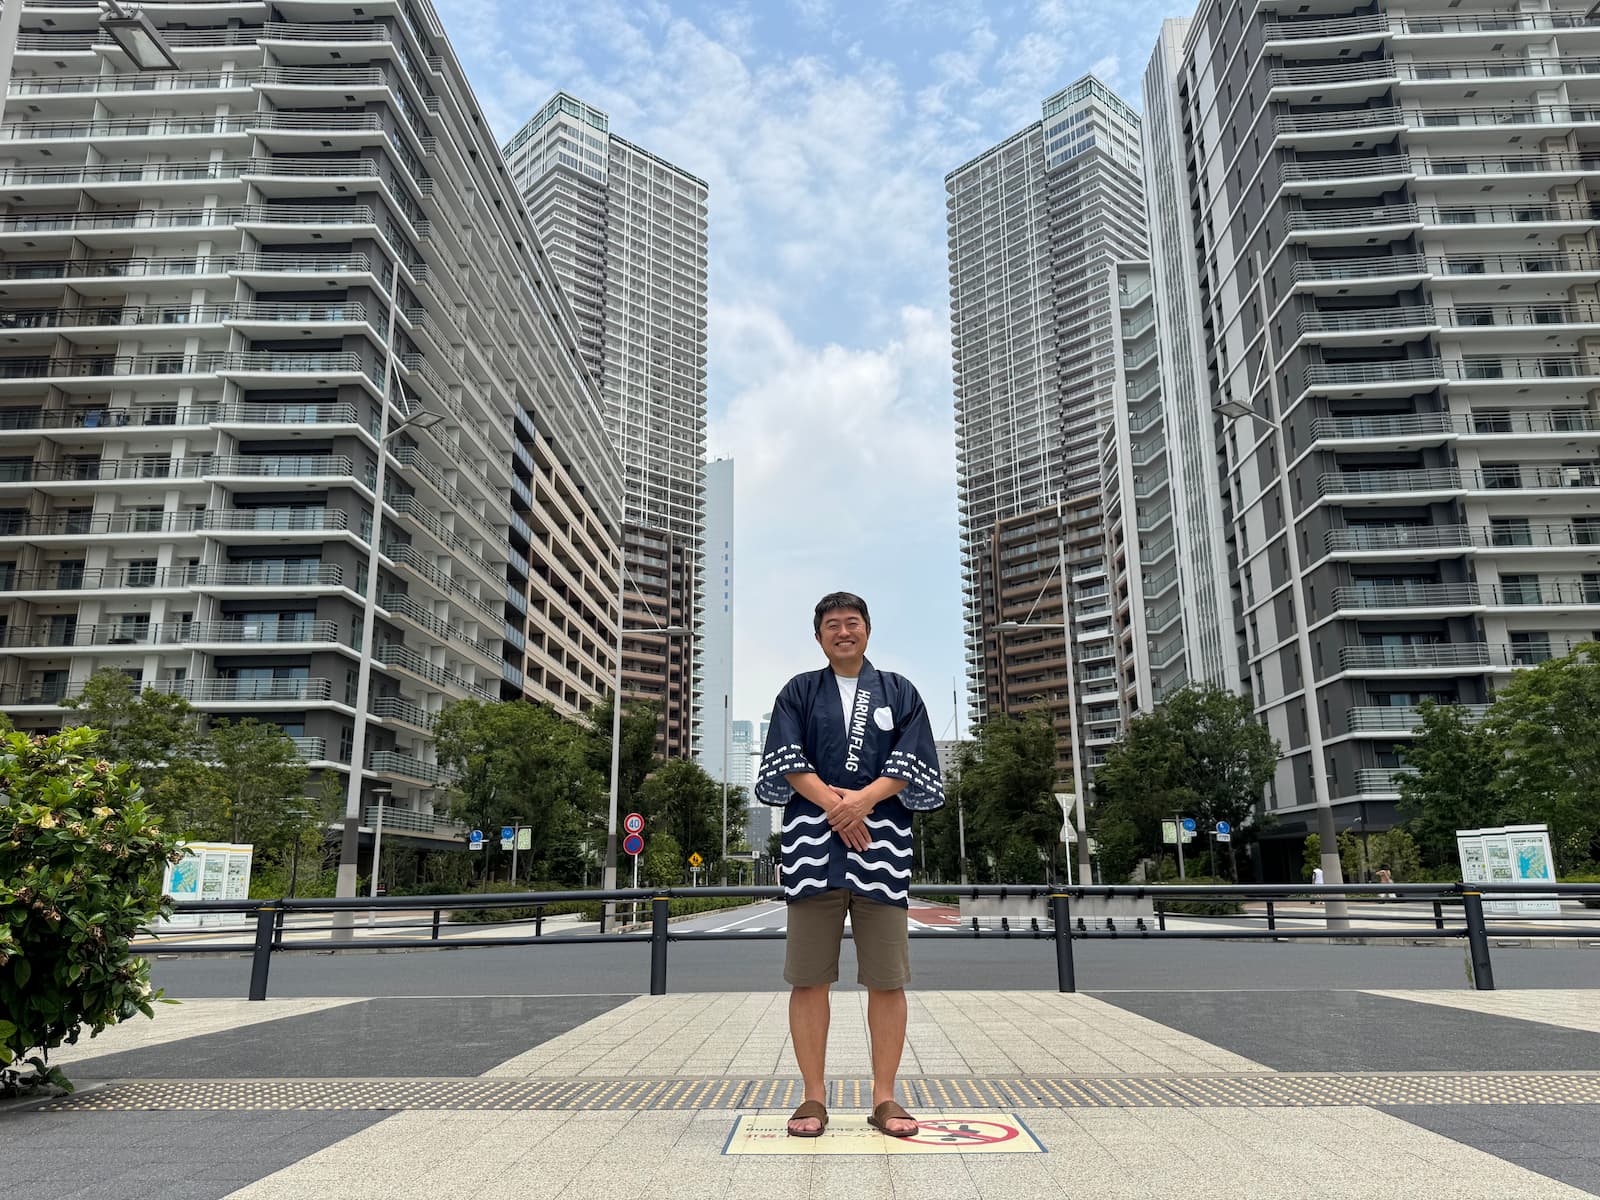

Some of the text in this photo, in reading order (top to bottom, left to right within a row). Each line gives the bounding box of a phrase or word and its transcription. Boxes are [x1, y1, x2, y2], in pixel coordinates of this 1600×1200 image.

[845, 689, 871, 772] HARUMI FLAG
[629, 819, 640, 828] 40
